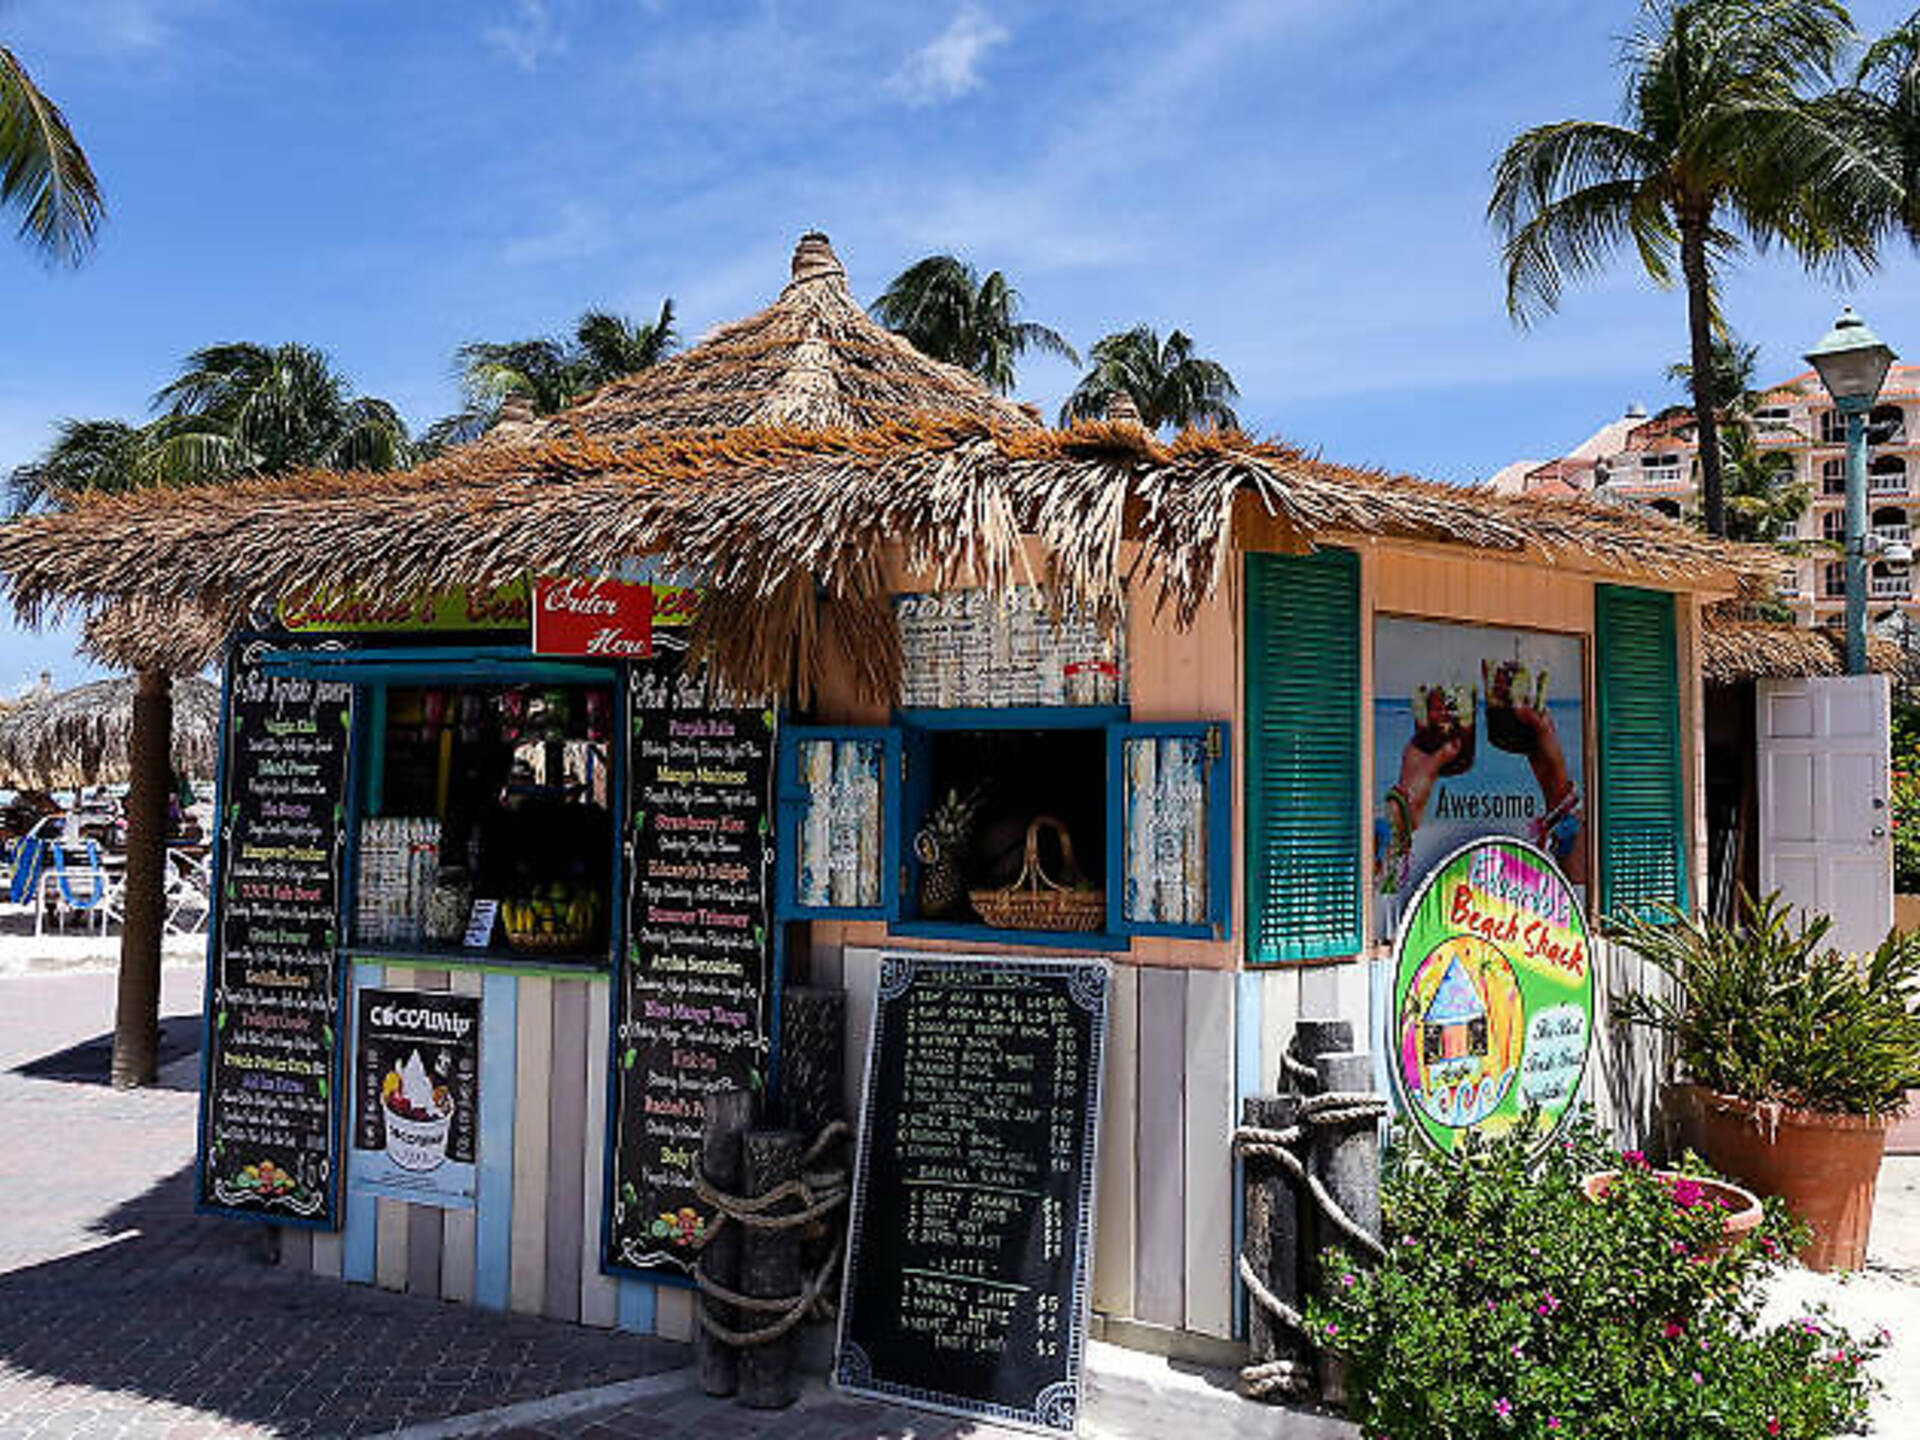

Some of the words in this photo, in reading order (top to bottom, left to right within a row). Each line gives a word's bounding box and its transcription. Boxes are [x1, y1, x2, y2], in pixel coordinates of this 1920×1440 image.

[544, 577, 617, 615] Order
[586, 626, 647, 654] Here
[1436, 786, 1535, 819] Awesome
[1450, 884, 1519, 941] Beach
[1523, 920, 1583, 977] Shack
